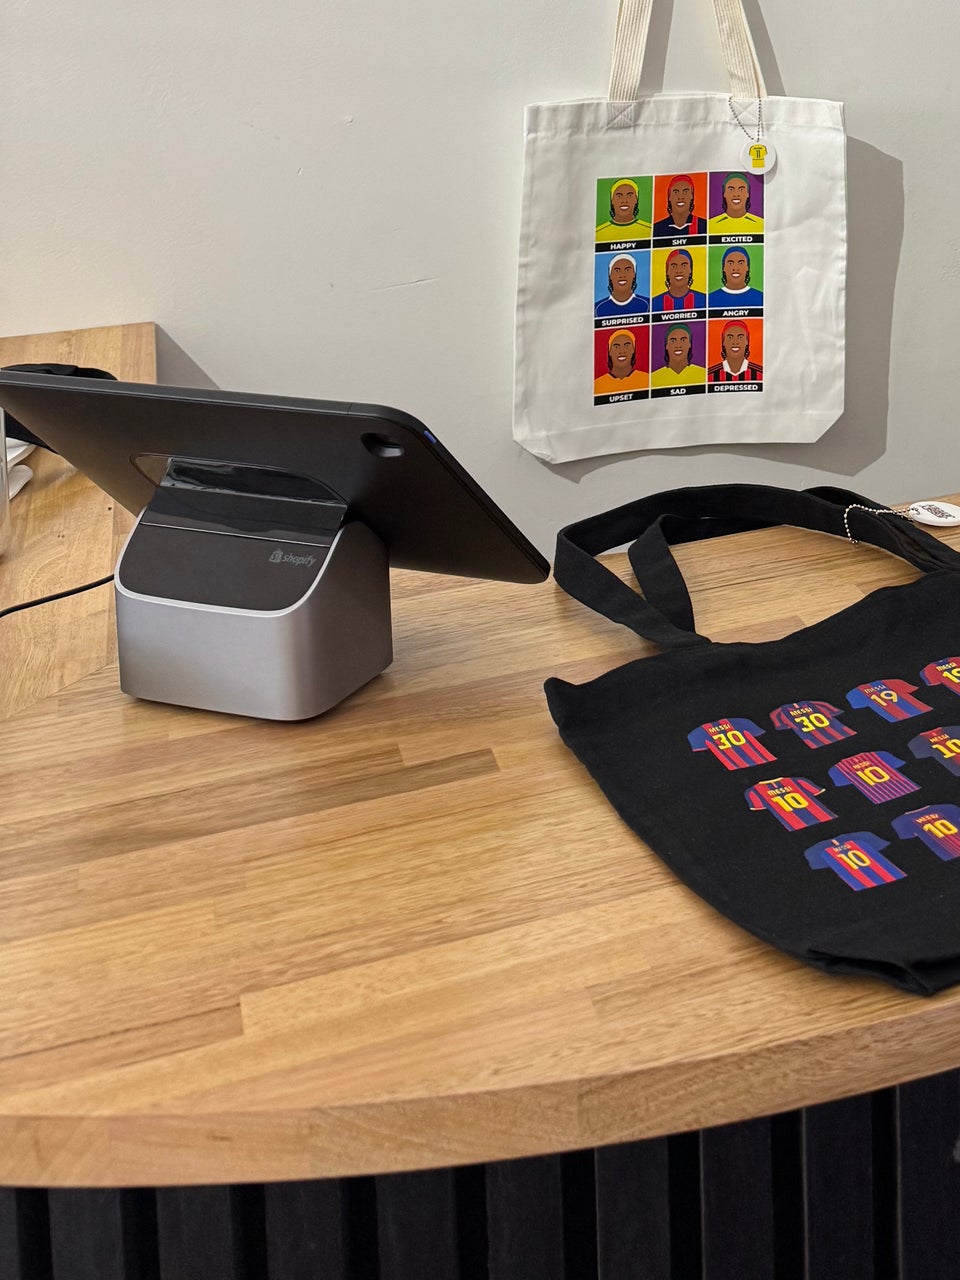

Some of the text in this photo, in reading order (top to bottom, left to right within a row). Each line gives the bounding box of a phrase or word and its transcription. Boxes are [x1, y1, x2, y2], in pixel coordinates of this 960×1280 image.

[672, 238, 688, 246] SHY
[721, 235, 753, 243] EXCITED
[610, 242, 637, 250] HAPPY
[661, 311, 698, 320] WORRIED
[722, 309, 749, 317] ANGRY
[601, 316, 644, 326] SURPRISED
[670, 387, 686, 396] SAD
[714, 383, 759, 392] DEPRESSED
[609, 394, 633, 403] UPSET
[870, 690, 898, 707] 19
[790, 707, 812, 717] MESSI
[794, 713, 830, 732] 30
[709, 723, 731, 734] MESSI
[712, 730, 746, 750] 30
[856, 766, 890, 786] 10
[767, 786, 793, 796] MESSI
[771, 792, 809, 812] 10
[922, 819, 959, 839] 10
[837, 849, 871, 870] 10
